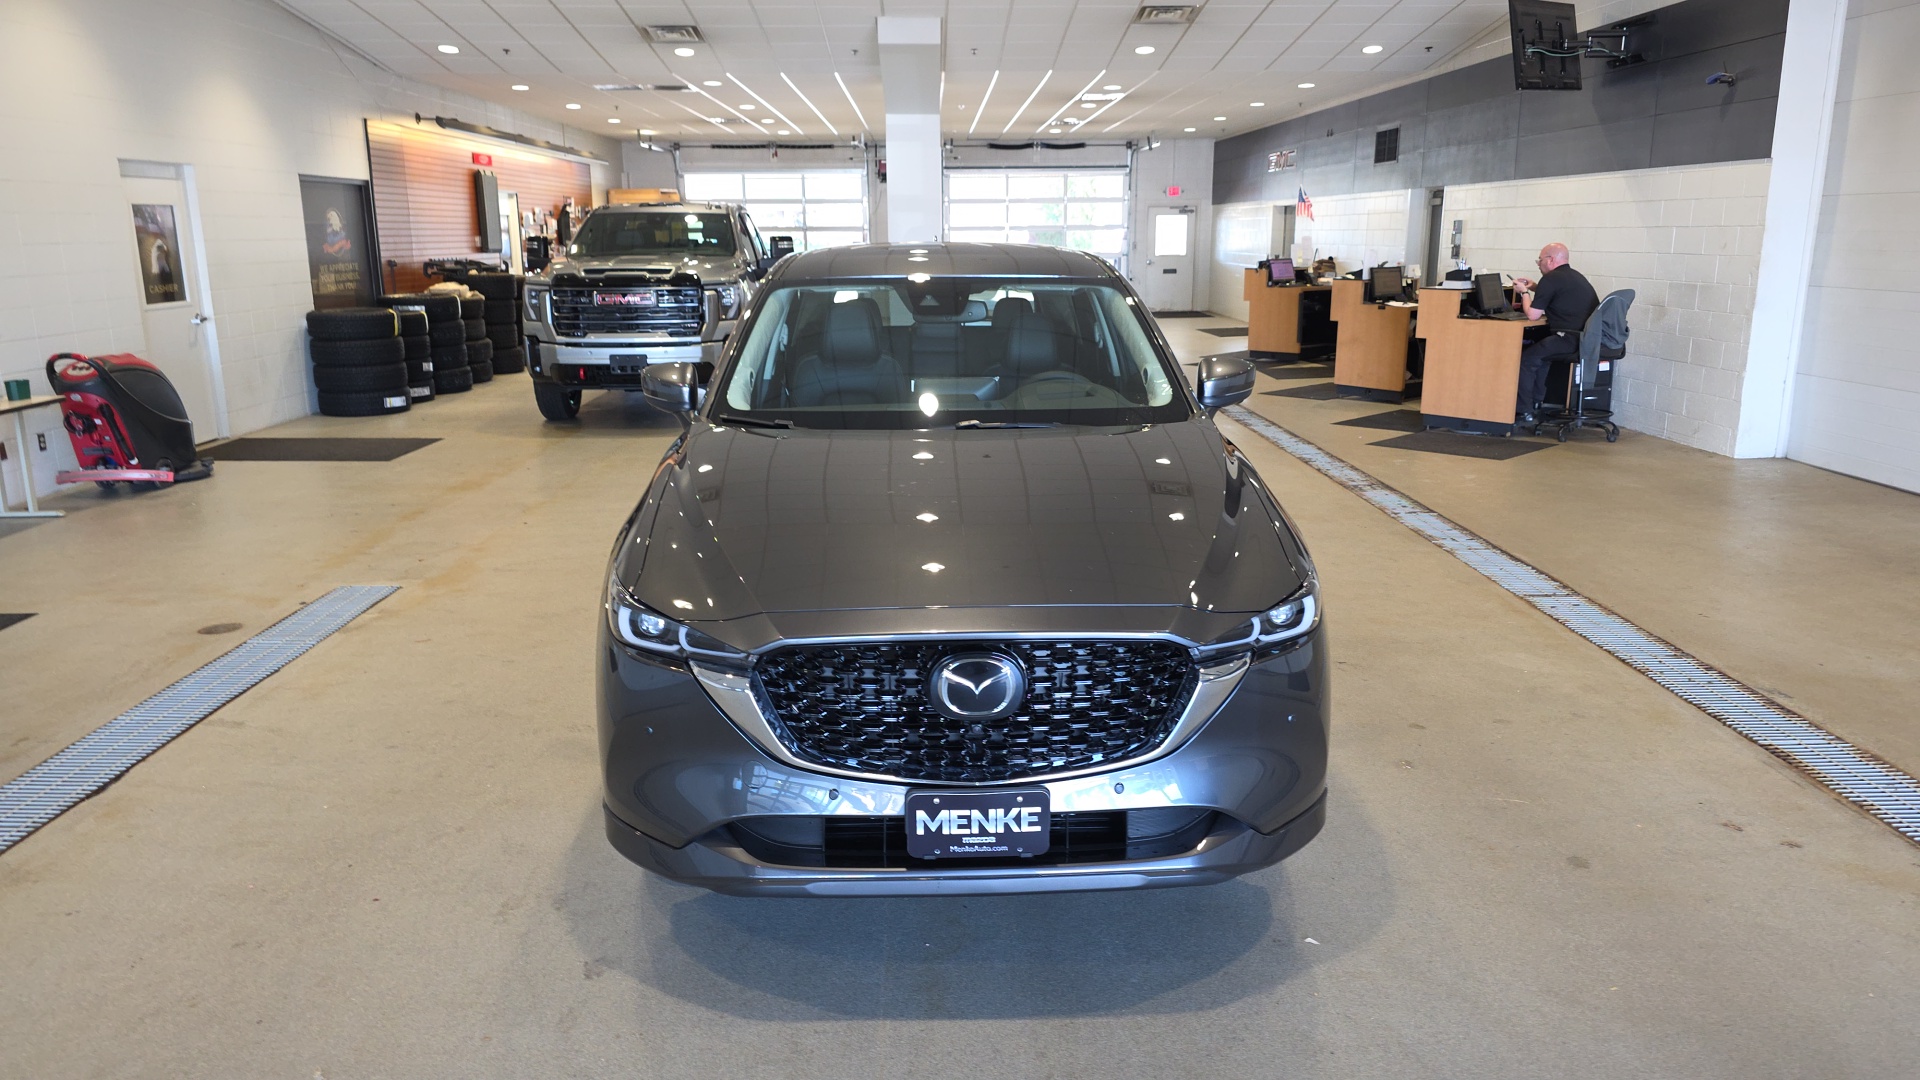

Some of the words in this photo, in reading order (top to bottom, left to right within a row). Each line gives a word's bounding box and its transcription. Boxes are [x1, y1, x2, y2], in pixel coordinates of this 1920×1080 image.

[329, 262, 359, 272] APPRECIATE
[149, 283, 179, 294] CASHIER
[597, 293, 654, 305] GMC
[915, 806, 1042, 836] MENKE
[950, 845, 1009, 853] MenkeAuto.com
